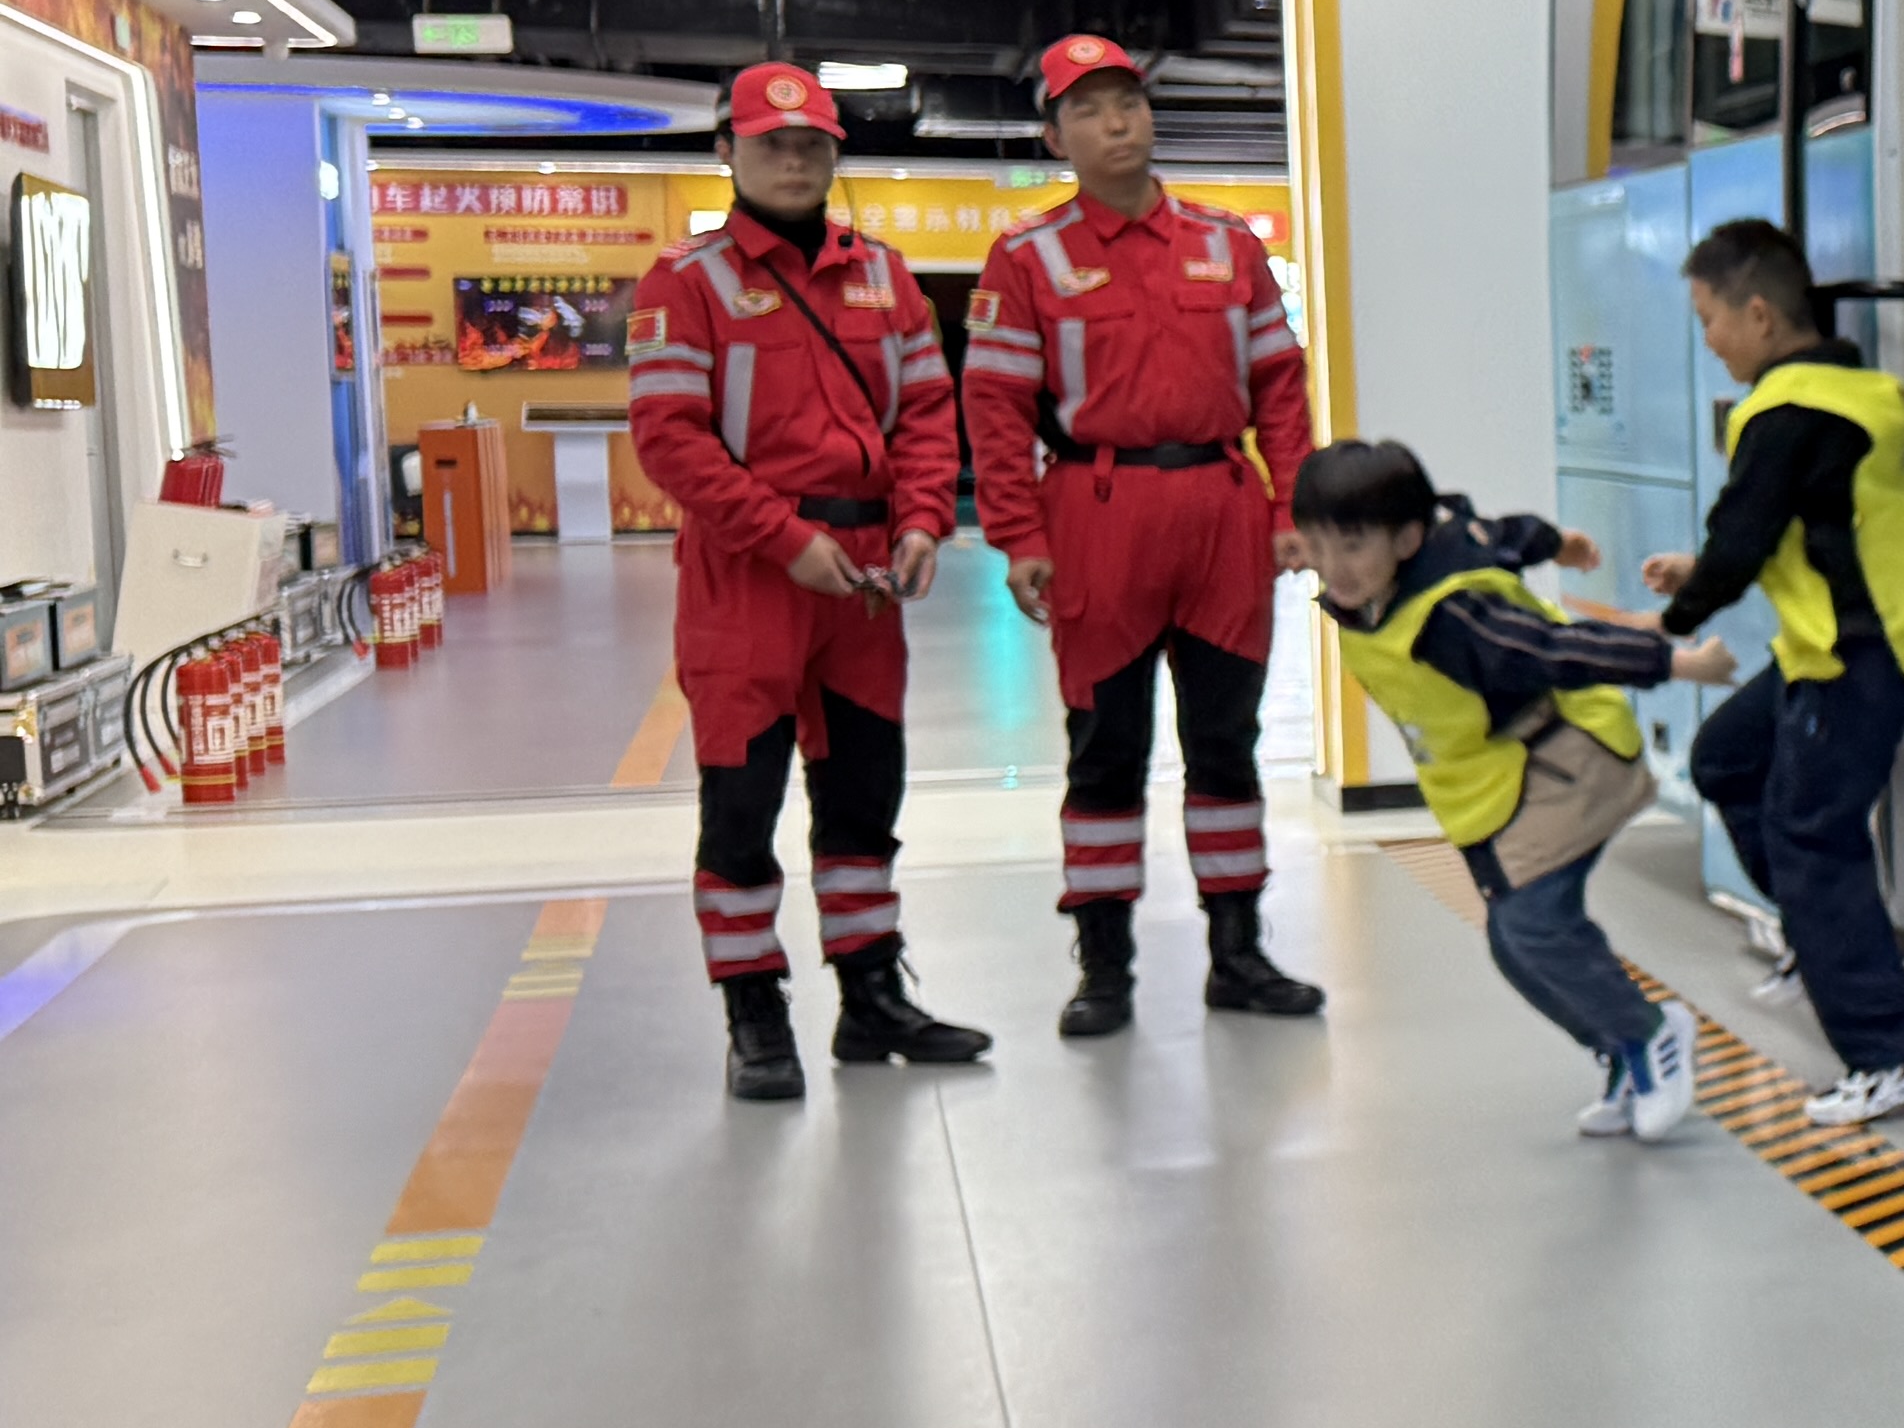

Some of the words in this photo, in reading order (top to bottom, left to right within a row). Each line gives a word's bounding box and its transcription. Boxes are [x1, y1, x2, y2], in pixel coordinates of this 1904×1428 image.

[371, 181, 620, 215] 车起火预防常识
